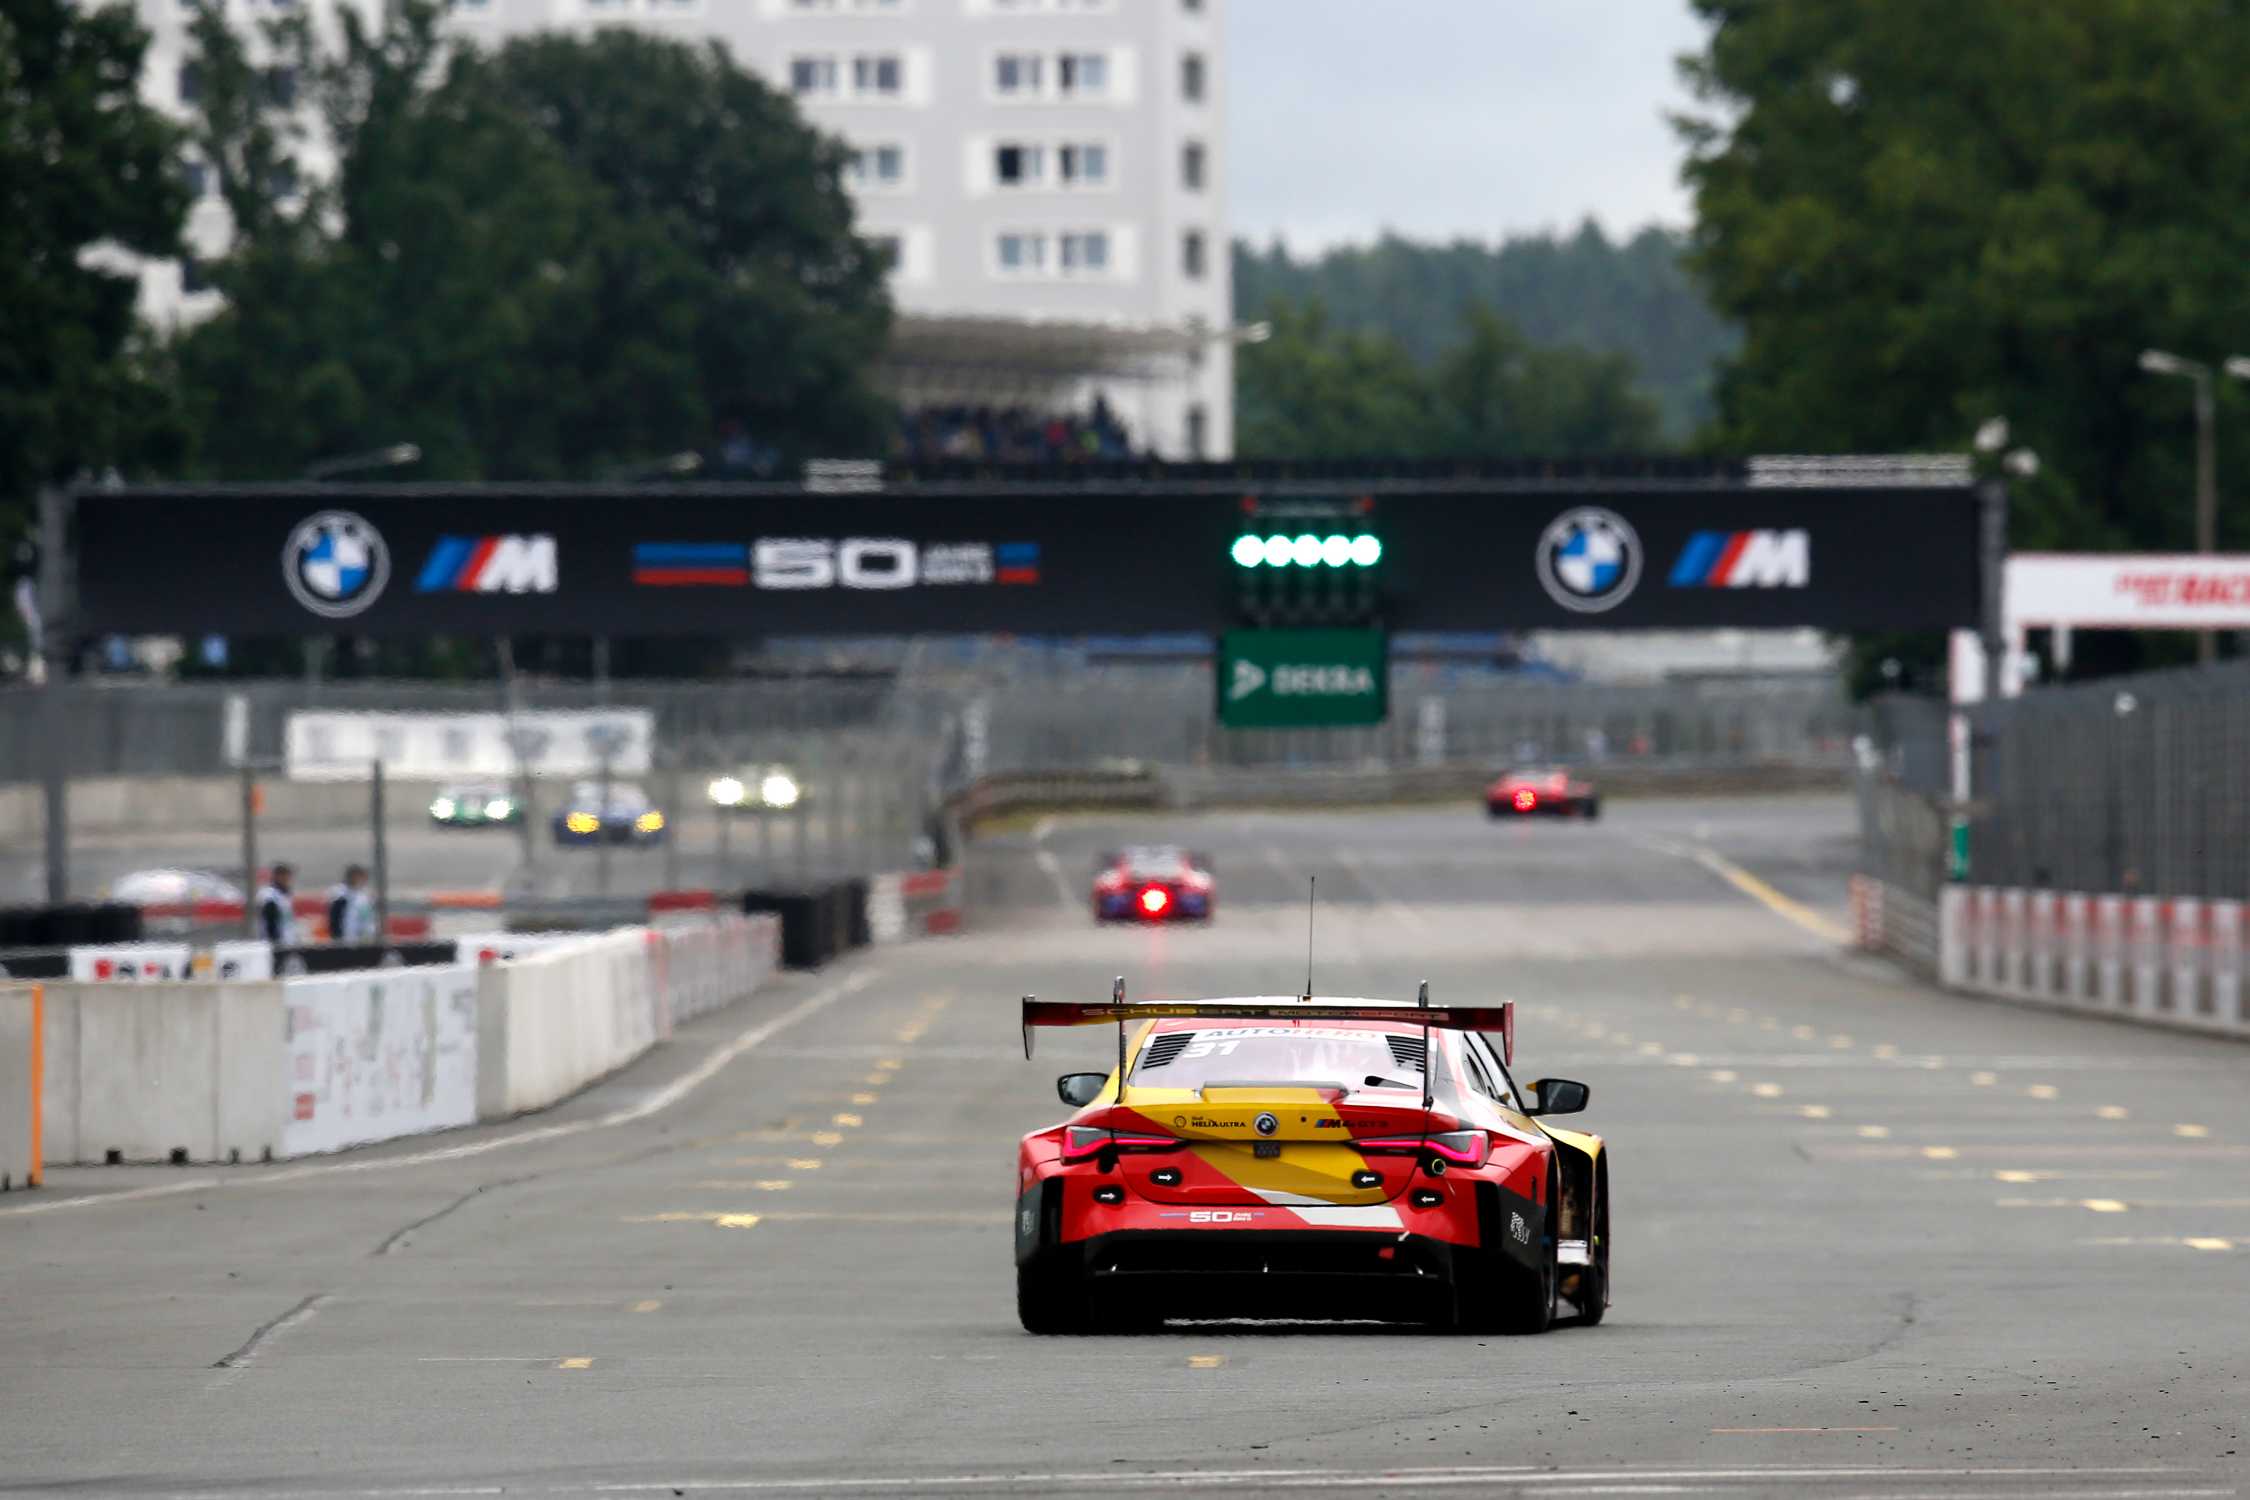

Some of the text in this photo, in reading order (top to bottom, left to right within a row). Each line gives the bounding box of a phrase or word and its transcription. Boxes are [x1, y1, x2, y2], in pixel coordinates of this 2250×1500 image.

[476, 534, 559, 592] M
[751, 537, 918, 589] 50
[1729, 528, 1810, 587] M
[1182, 1040, 1241, 1058] 31
[1189, 1211, 1233, 1223] 50
